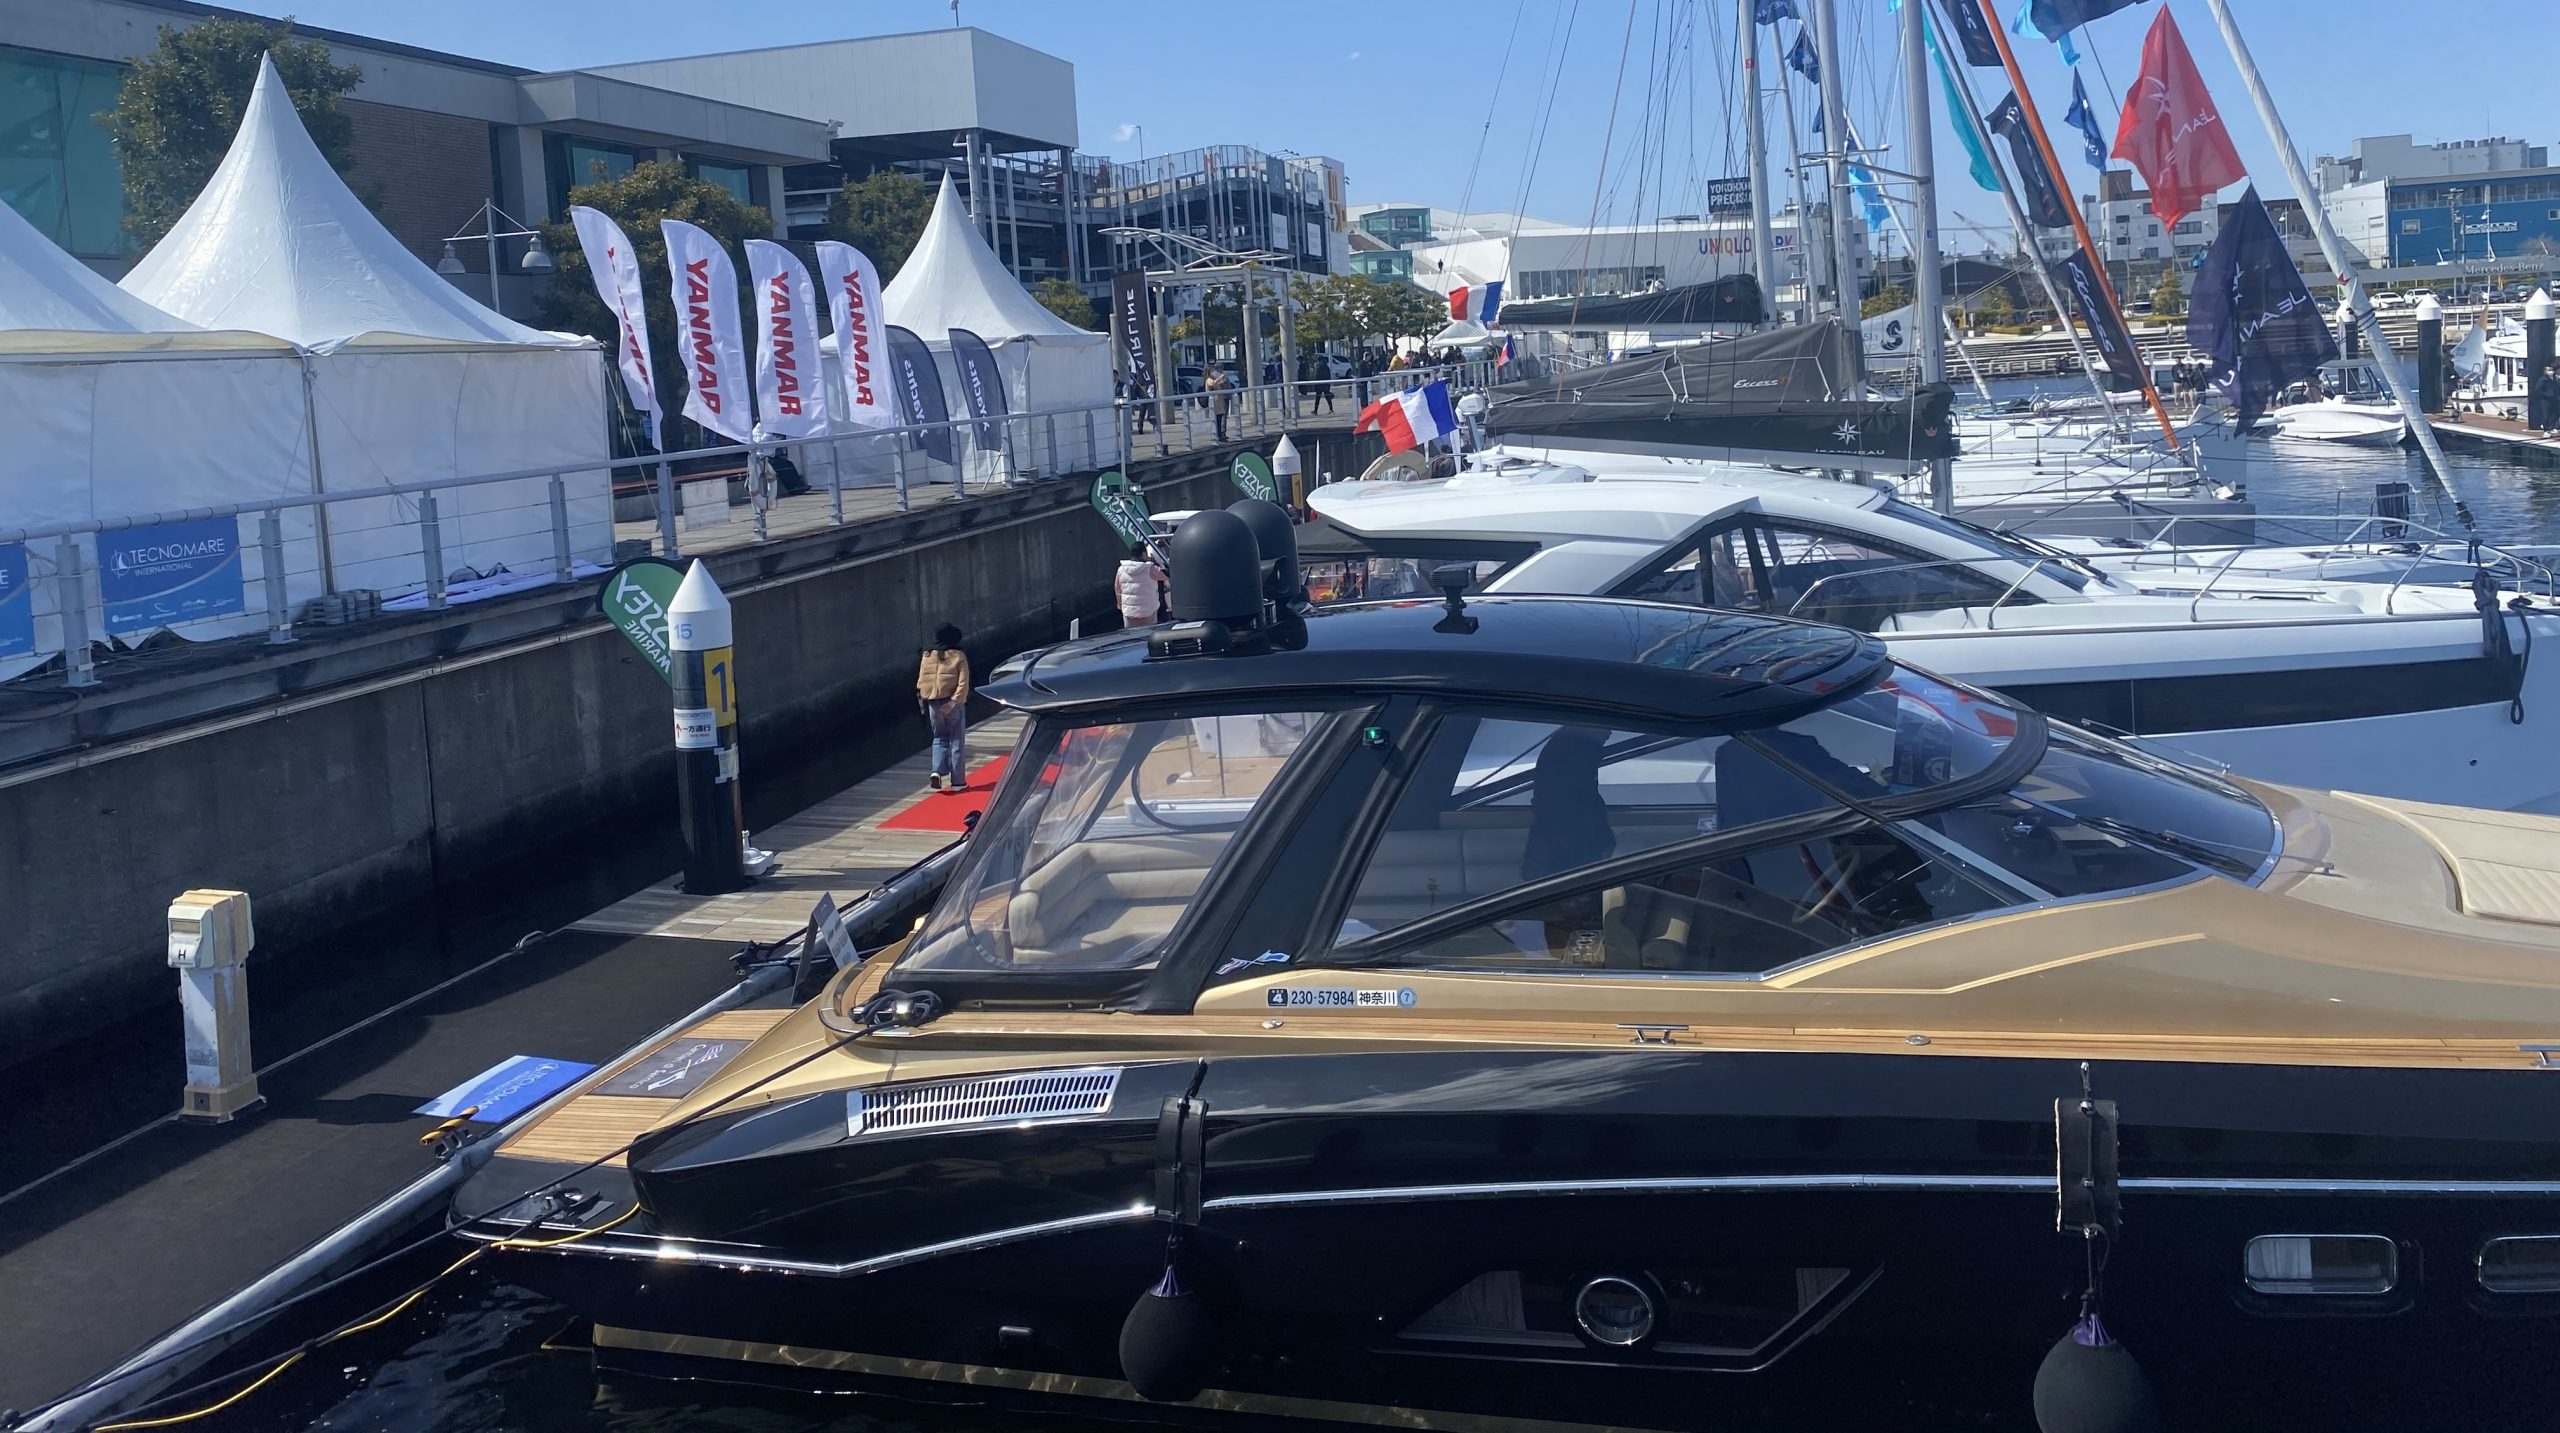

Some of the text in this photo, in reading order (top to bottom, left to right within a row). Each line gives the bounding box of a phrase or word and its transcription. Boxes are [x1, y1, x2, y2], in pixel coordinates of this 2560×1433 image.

[1699, 237, 1752, 255] UNIQLO
[2465, 262, 2545, 275] Mercedes-Benz
[770, 271, 802, 417] YANMAR
[842, 269, 874, 407] YANMAR
[1733, 378, 1779, 389] Excess
[1278, 462, 1288, 470] 16
[130, 538, 225, 564] TECNOMARE
[135, 562, 193, 577] INTERNATIONAL
[674, 623, 693, 640] 15
[682, 724, 711, 733] 一方通行
[178, 949, 186, 959] H
[1291, 990, 1354, 1005] 230-57984
[1358, 991, 1396, 1005] 神奈川
